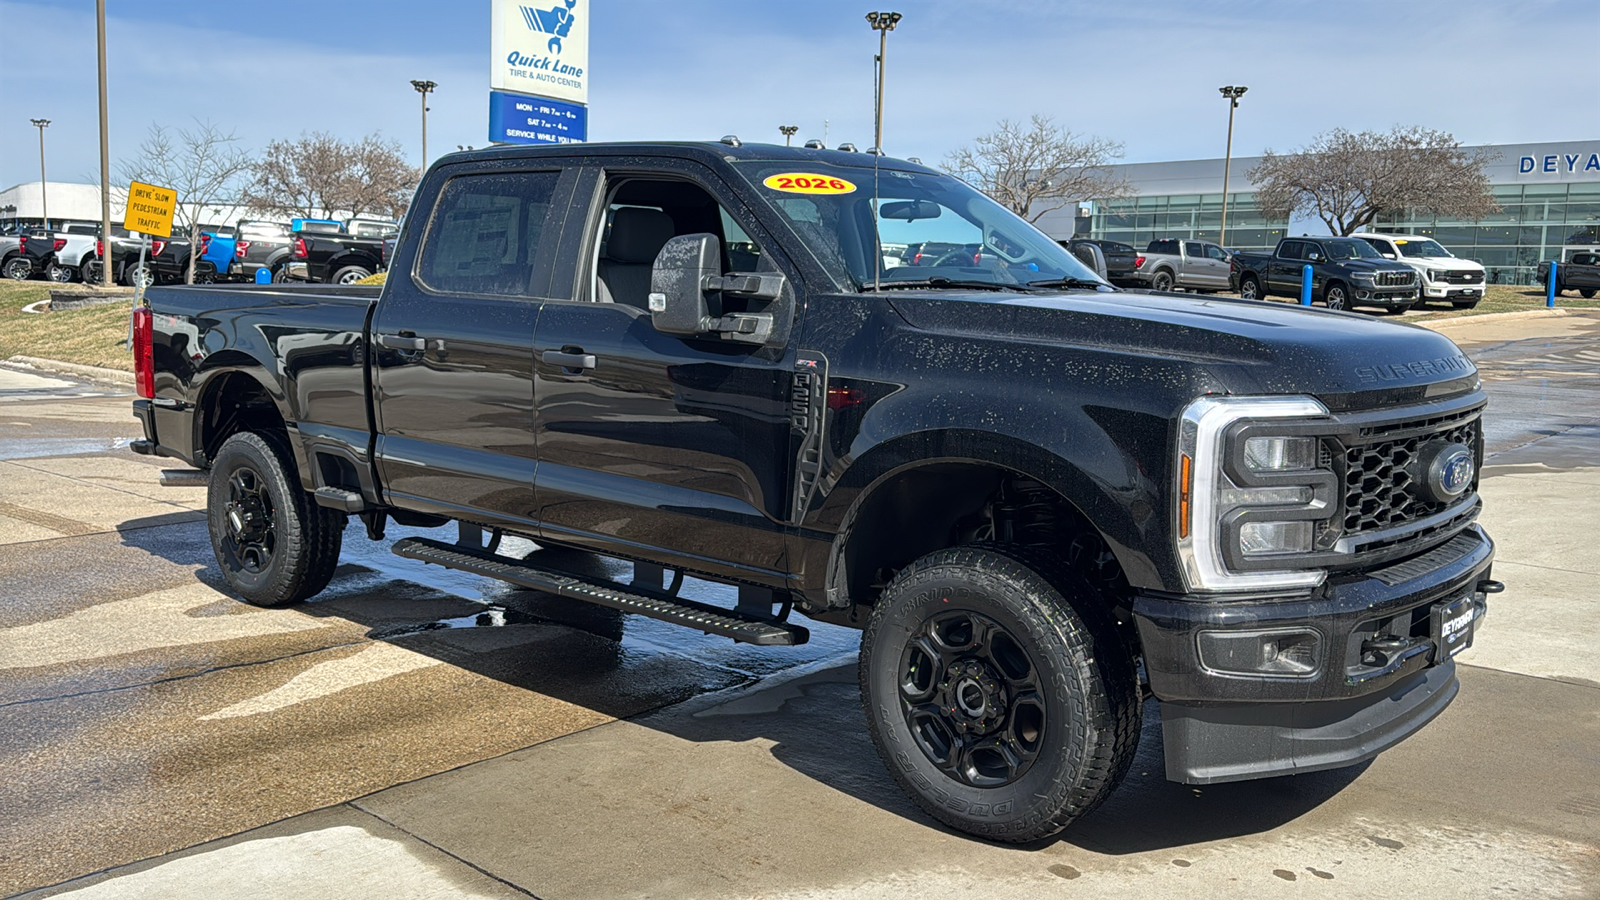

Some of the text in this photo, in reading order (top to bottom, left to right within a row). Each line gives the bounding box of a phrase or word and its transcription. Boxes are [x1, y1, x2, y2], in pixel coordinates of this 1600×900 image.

[507, 51, 583, 77] Quick Lane
[509, 69, 527, 78] TIRE
[536, 73, 556, 83] AUTO
[557, 77, 581, 88] CENTER
[516, 103, 532, 111] MON
[527, 118, 540, 126] SAT
[506, 129, 535, 139] SERVICE
[537, 132, 556, 142] WHILE
[777, 177, 846, 190] 2026
[135, 189, 169, 203] DRIVE SLOW
[133, 202, 167, 216] PEDESTRIAN
[137, 217, 160, 229] TRAFFIC
